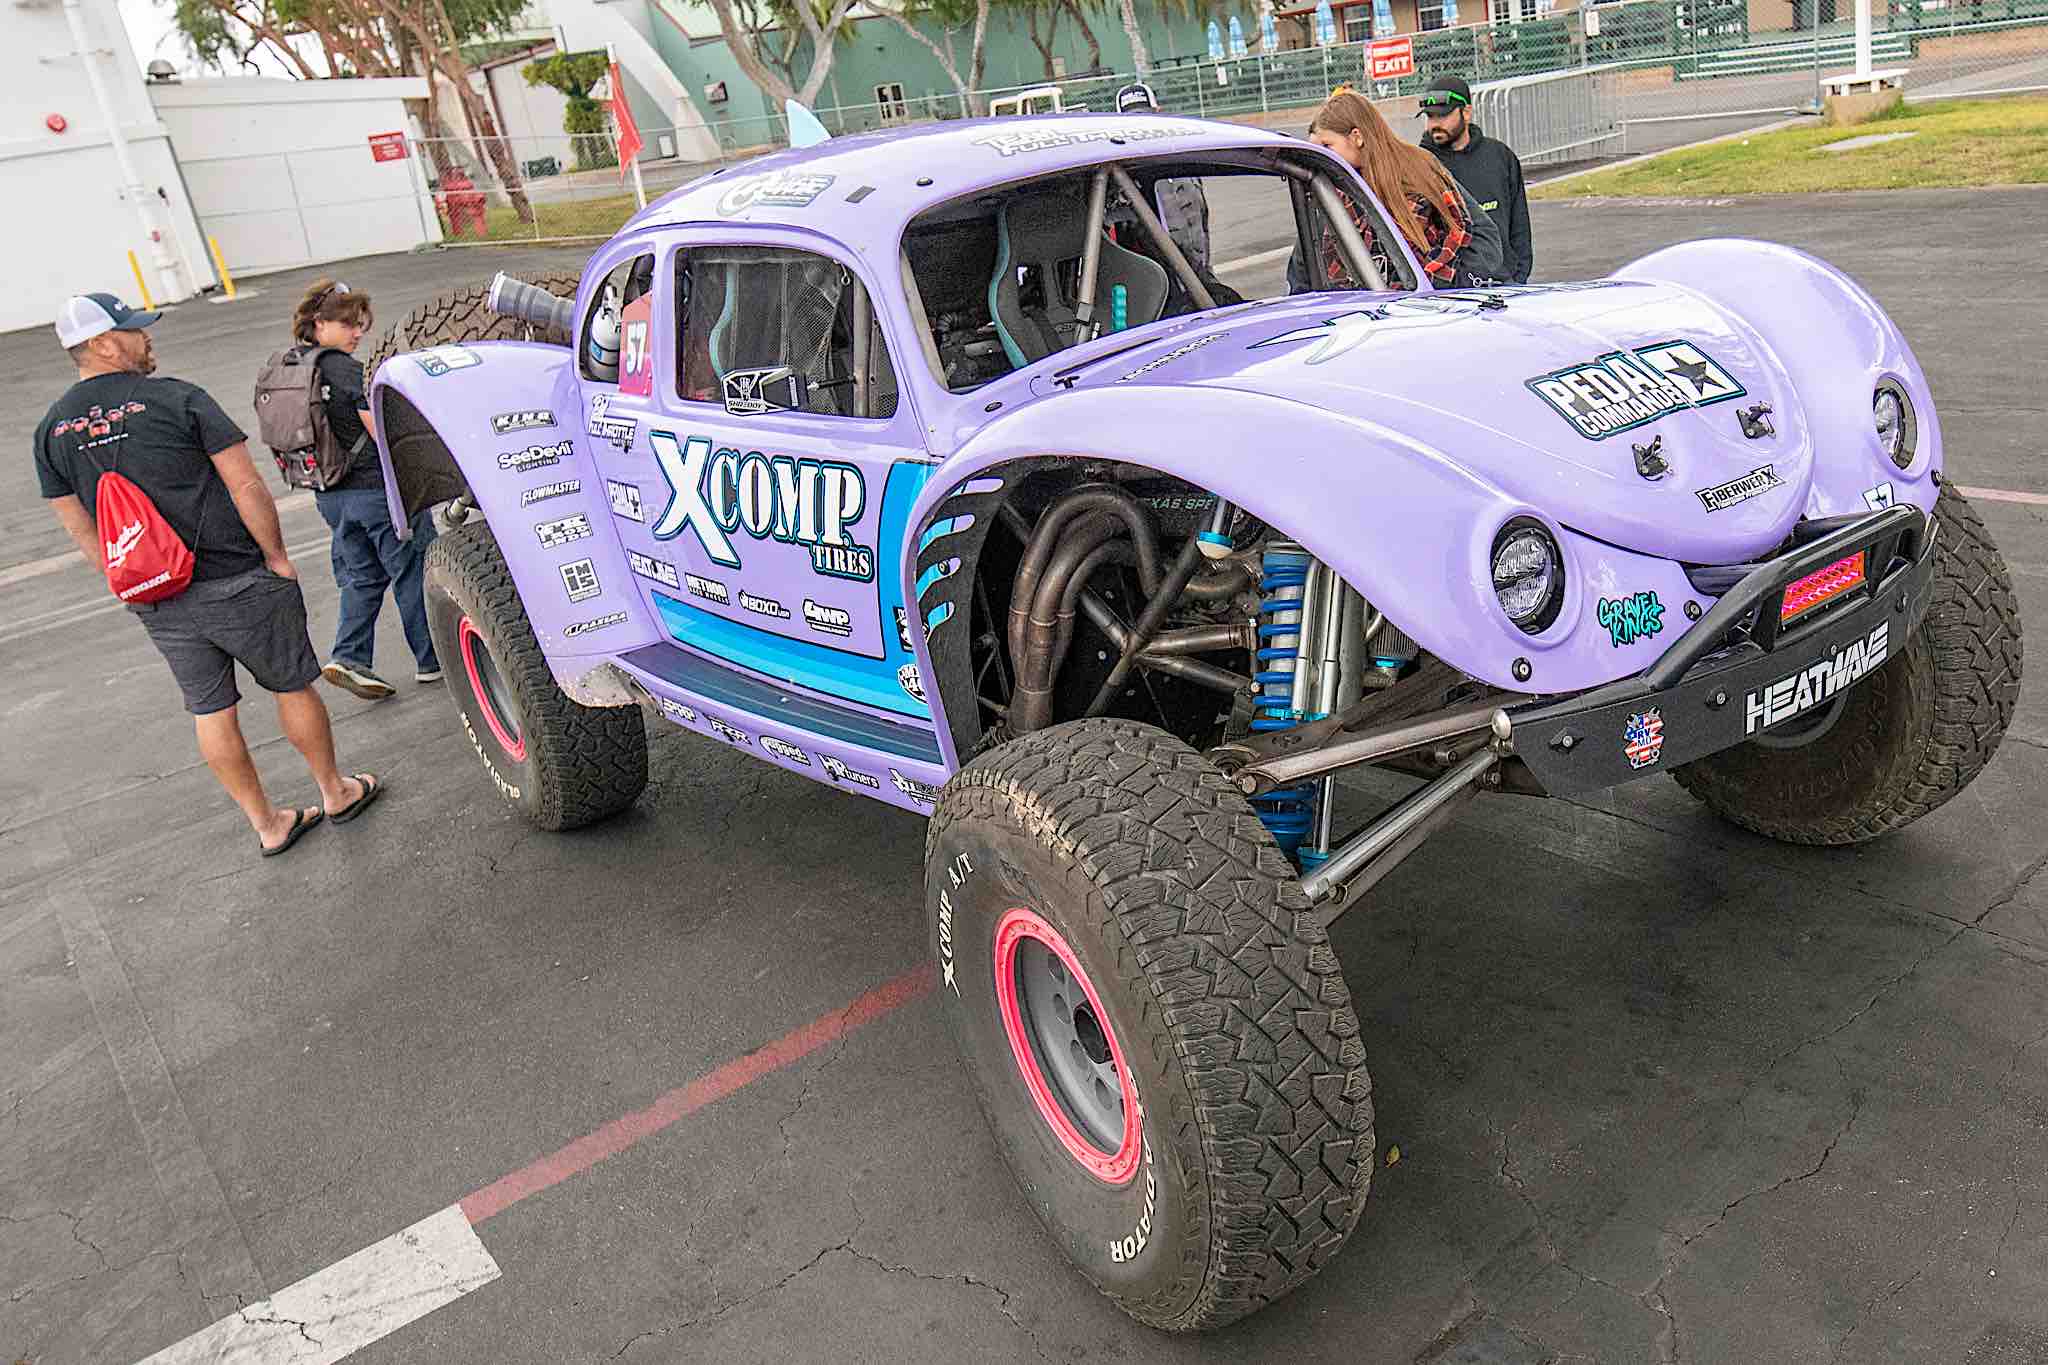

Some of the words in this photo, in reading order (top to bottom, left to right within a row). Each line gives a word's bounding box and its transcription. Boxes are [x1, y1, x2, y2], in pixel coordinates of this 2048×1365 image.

[1375, 56, 1410, 73] EXIT
[626, 321, 648, 376] 57
[1533, 353, 1674, 419] PEDAL
[498, 442, 572, 469] SeeDevil
[521, 480, 580, 508] FLOWMASTER
[813, 545, 870, 576] TIRES
[748, 597, 779, 615] BOXO
[1746, 620, 1889, 735] HEATWAVE
[948, 852, 974, 890] A/T
